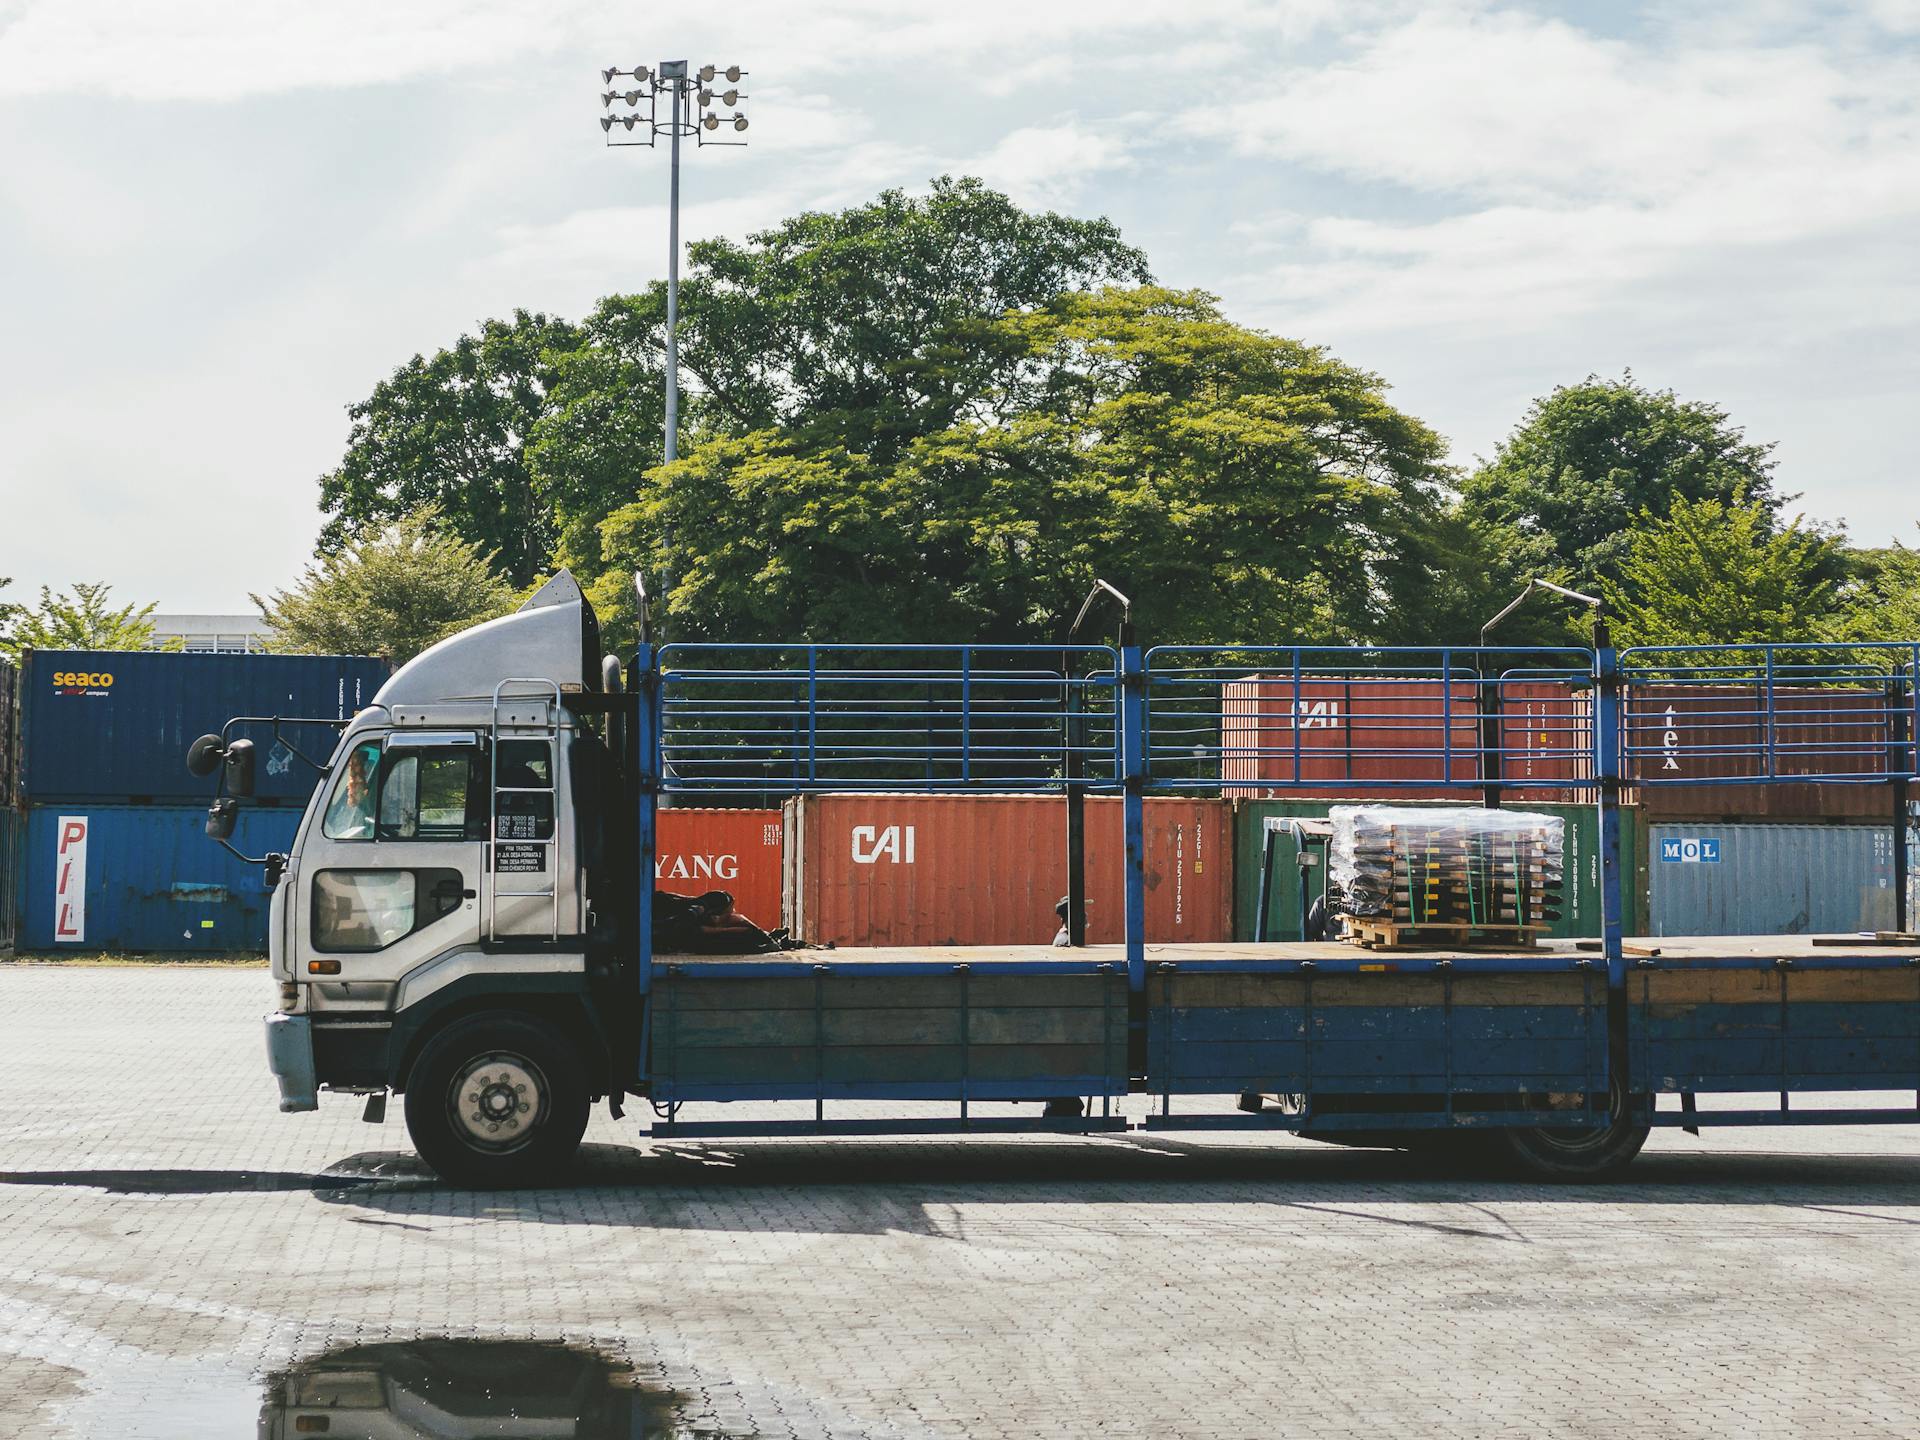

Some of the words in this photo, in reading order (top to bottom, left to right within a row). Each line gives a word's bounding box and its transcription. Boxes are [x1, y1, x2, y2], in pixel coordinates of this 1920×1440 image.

[53, 671, 114, 687] seaco
[1290, 700, 1338, 728] CAI
[1661, 704, 1680, 770] tex
[851, 825, 915, 864] CAI
[1664, 843, 1718, 859] MOL
[57, 822, 86, 936] PIL
[655, 854, 739, 880] YANG
